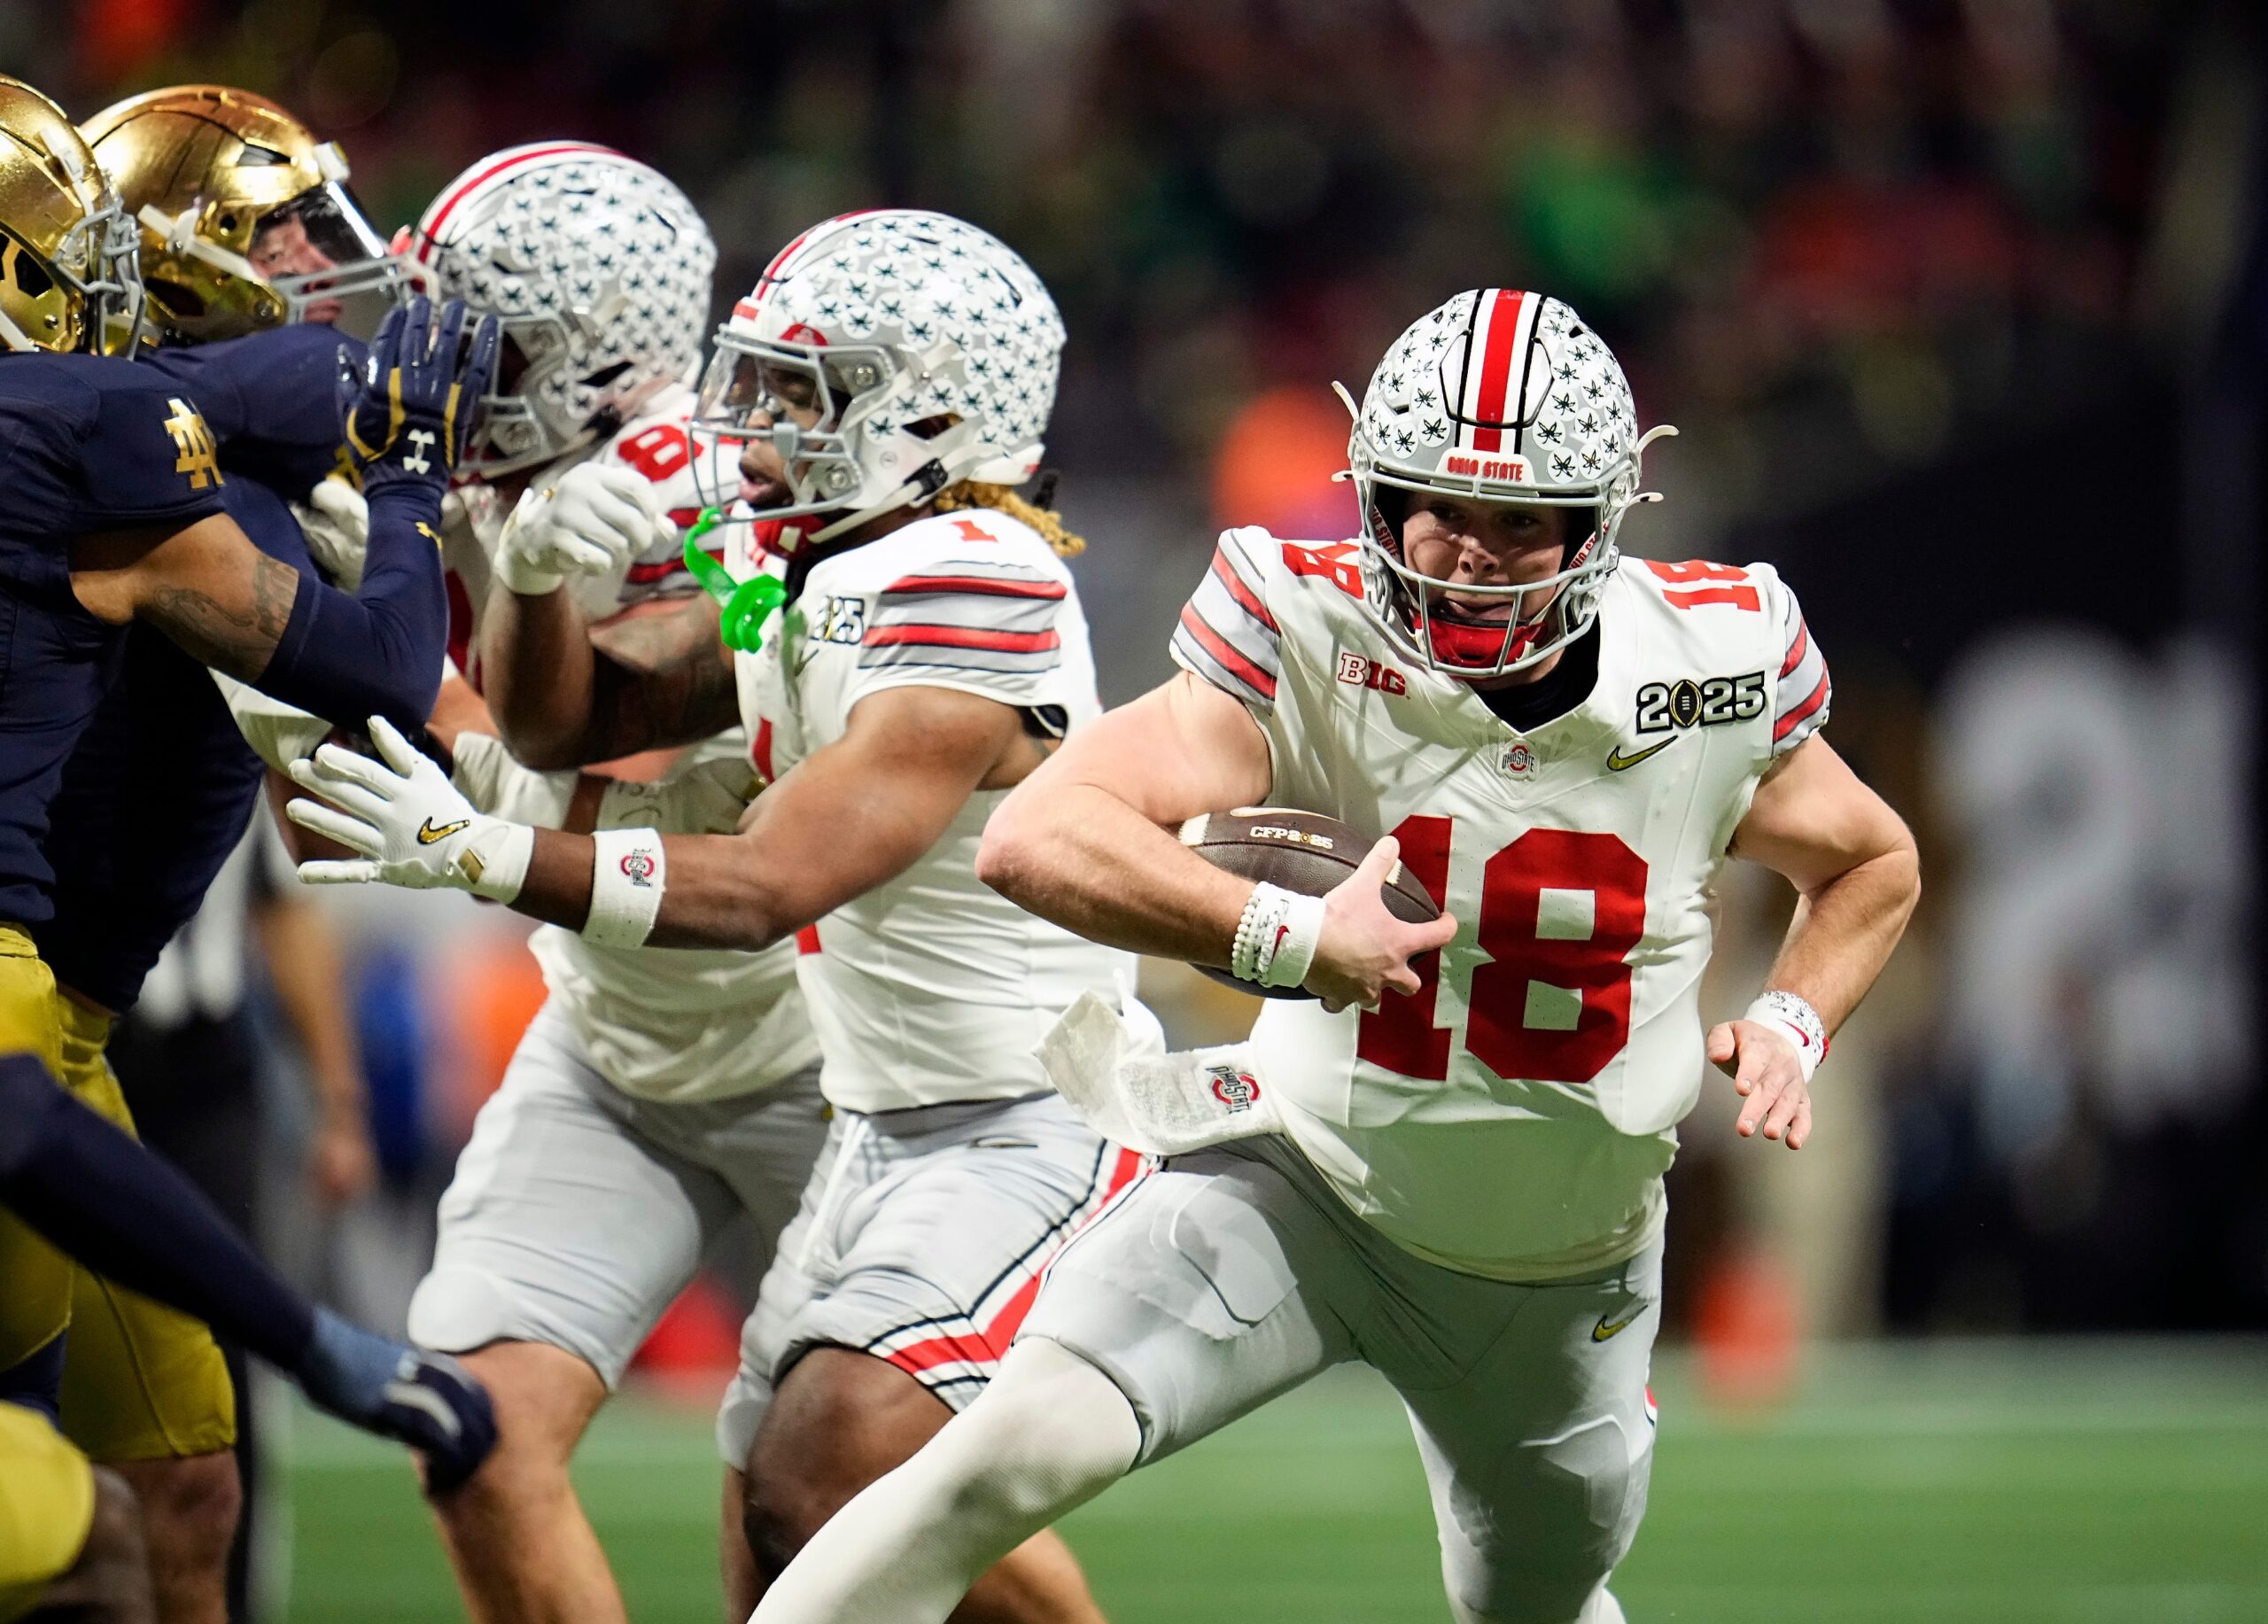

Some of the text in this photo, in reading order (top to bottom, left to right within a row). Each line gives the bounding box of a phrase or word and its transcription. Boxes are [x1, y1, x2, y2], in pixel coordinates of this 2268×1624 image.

[1447, 456, 1523, 481] OHIO STATE
[1356, 814, 1649, 1084] 18
